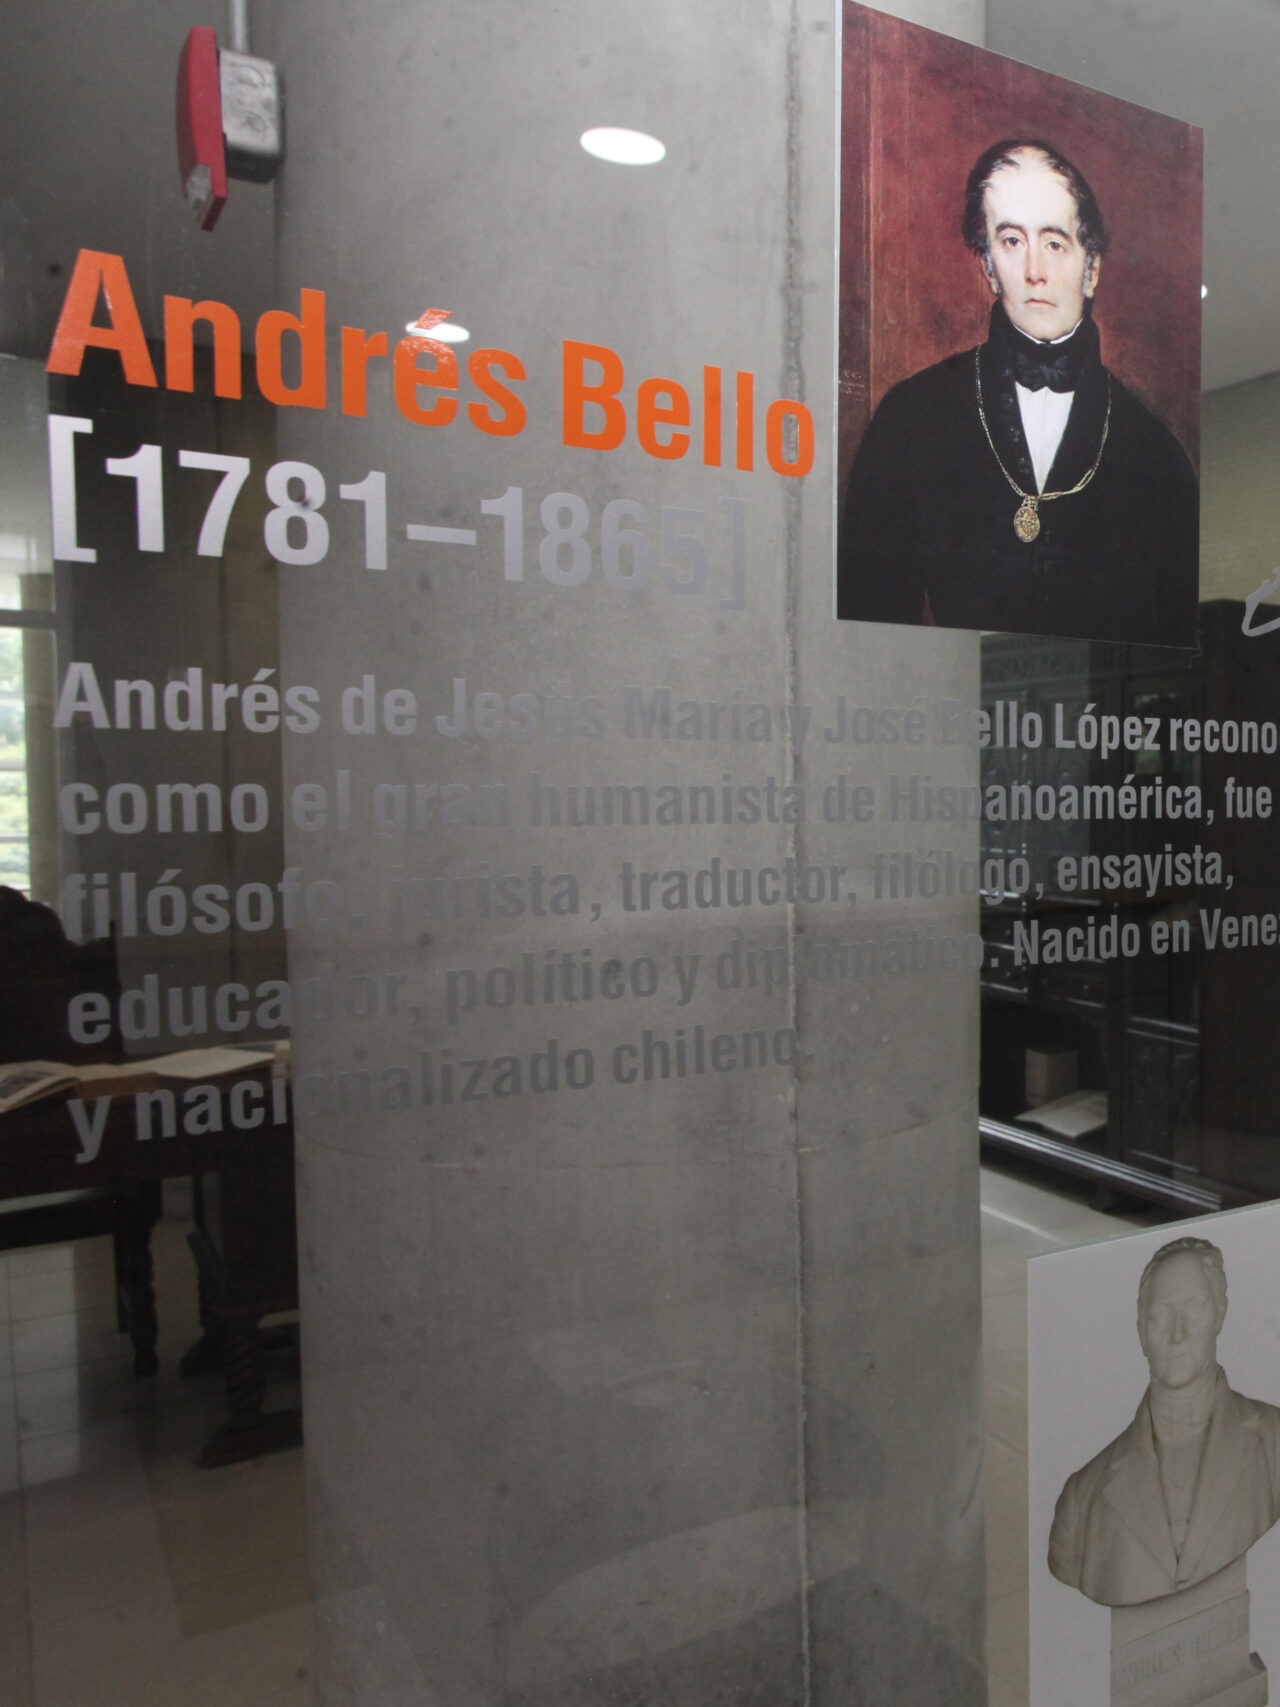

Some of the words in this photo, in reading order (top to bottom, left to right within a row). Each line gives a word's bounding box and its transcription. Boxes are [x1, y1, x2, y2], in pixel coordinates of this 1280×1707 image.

[45, 247, 528, 438] Andrés
[562, 339, 816, 479] Bello
[53, 661, 321, 734] Andrés
[340, 674, 418, 736] de
[436, 678, 606, 738] Jesús
[624, 684, 773, 741] María
[786, 702, 811, 754] y
[823, 694, 928, 745] José
[941, 699, 1043, 749] Bello
[1055, 703, 1161, 759] López
[61, 781, 270, 835] como
[291, 769, 350, 832] el
[373, 783, 512, 838] gran
[529, 770, 807, 826] humanista
[822, 774, 876, 824] de
[889, 773, 1215, 829] Hispanoamérica,
[1224, 777, 1272, 819] fue
[619, 857, 856, 913] traductor,
[873, 846, 1045, 905] filólogo,
[1057, 843, 1234, 898] ensayista,
[67, 963, 421, 1044] educador,
[445, 948, 659, 1025] político
[674, 953, 701, 1006] y
[1013, 915, 1140, 966] Nacido
[1150, 919, 1190, 955] en
[67, 1094, 111, 1164] y
[135, 1038, 595, 1141] nacionalizado
[612, 1025, 815, 1085] chileno.
